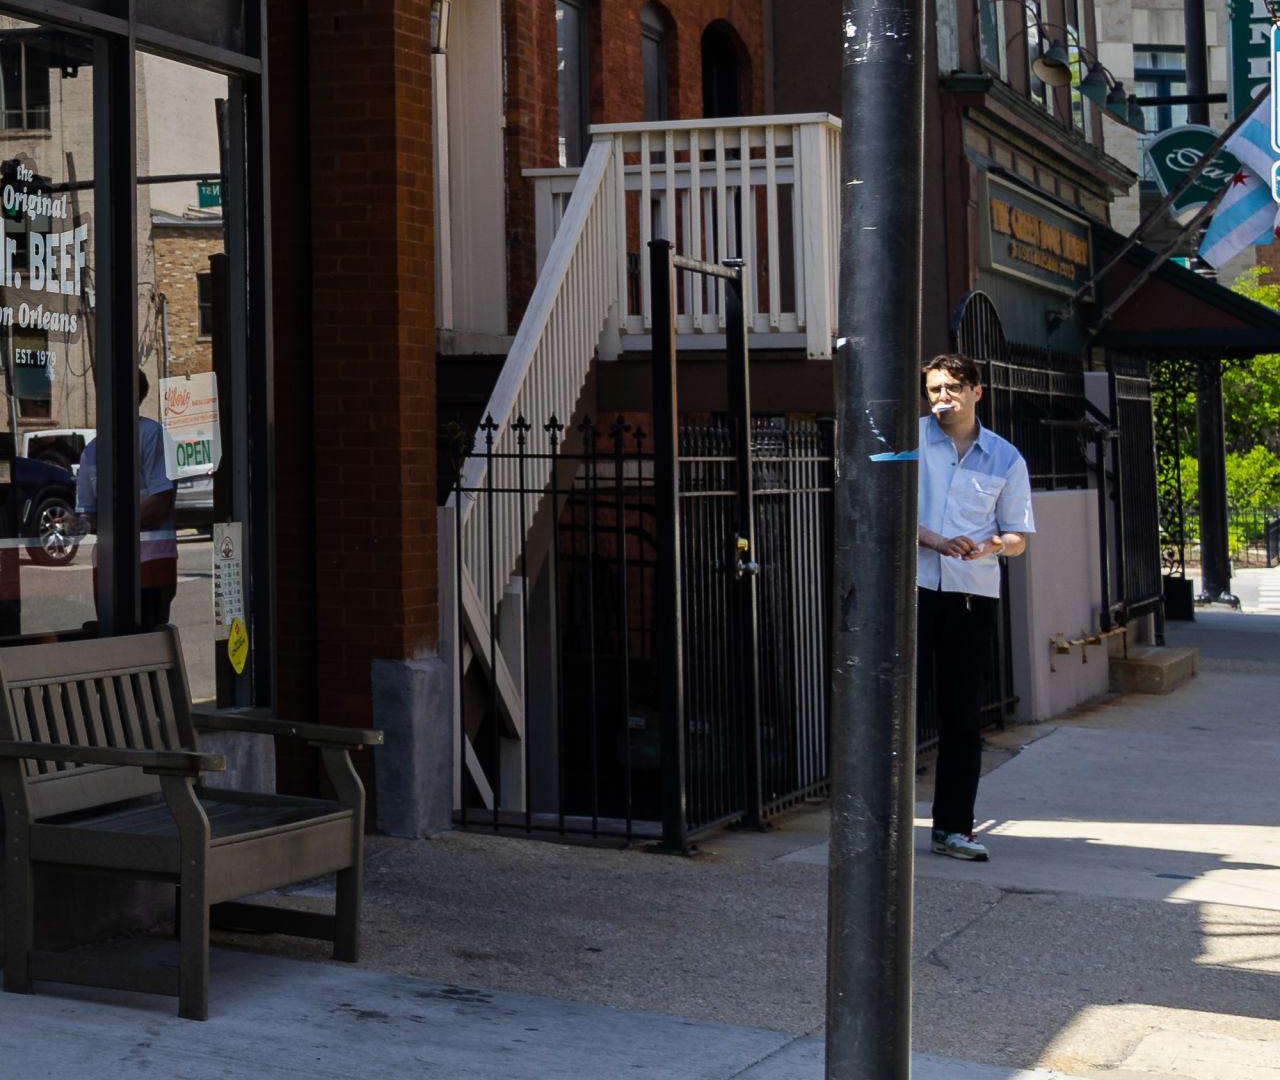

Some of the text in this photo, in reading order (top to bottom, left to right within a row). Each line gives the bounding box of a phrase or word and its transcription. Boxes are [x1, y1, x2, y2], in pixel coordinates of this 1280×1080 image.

[17, 164, 33, 182] the
[3, 184, 67, 220] Original
[29, 223, 88, 296] BEEF
[18, 303, 77, 333] Orleans
[15, 348, 56, 366] EST. 1979
[176, 440, 211, 466] OPEN
